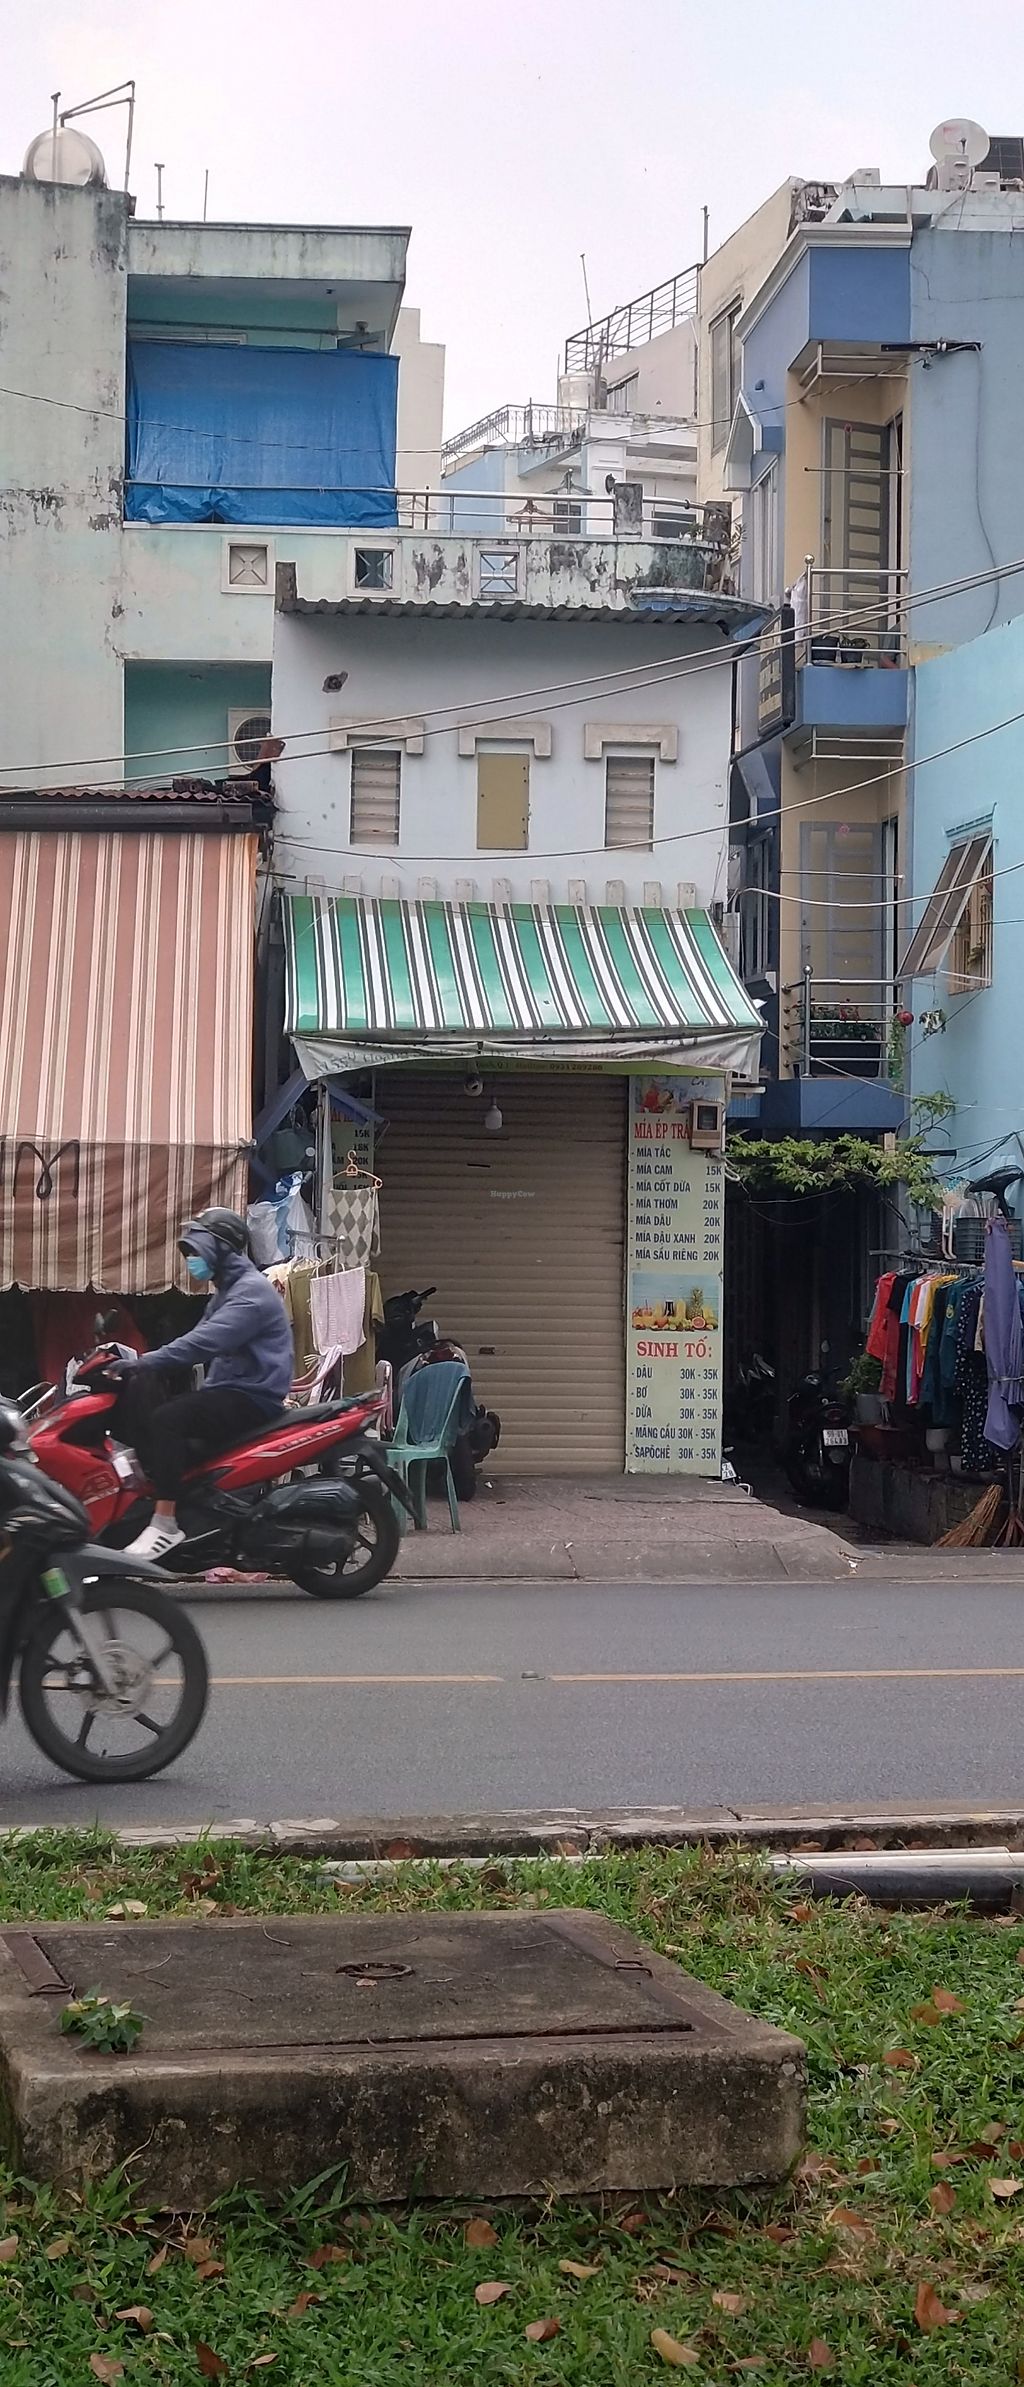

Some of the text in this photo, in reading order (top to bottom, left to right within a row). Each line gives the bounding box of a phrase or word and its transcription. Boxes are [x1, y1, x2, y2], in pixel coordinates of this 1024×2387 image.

[655, 1118, 668, 1138] ÉP
[671, 1118, 690, 1139] TRÁ
[636, 1146, 652, 1158] MÍA
[636, 1162, 722, 1175] MÍA CAM 15K
[636, 1179, 652, 1192] MÍA
[705, 1183, 721, 1192] 15K
[636, 1196, 652, 1209] MÍA
[703, 1200, 719, 1210] 20K
[636, 1213, 652, 1225] MÍA
[704, 1217, 720, 1227] 20K
[636, 1230, 651, 1242] MÍA
[673, 1233, 696, 1243] XANH
[704, 1234, 720, 1243] 20K
[636, 1247, 651, 1259] MÍA
[672, 1248, 698, 1260] RIÊNG
[703, 1251, 719, 1261] 20K
[637, 1335, 712, 1358] SINH TỐ:
[680, 1368, 695, 1380] 30K
[703, 1369, 718, 1380] 35K
[680, 1388, 695, 1399] 30K
[702, 1389, 718, 1400] 35K
[679, 1408, 695, 1419] 30K
[702, 1408, 718, 1419] 35K
[677, 1428, 693, 1439] 30K
[700, 1428, 716, 1439] 35K
[678, 1448, 694, 1459] 30K
[701, 1448, 717, 1459] 35K
